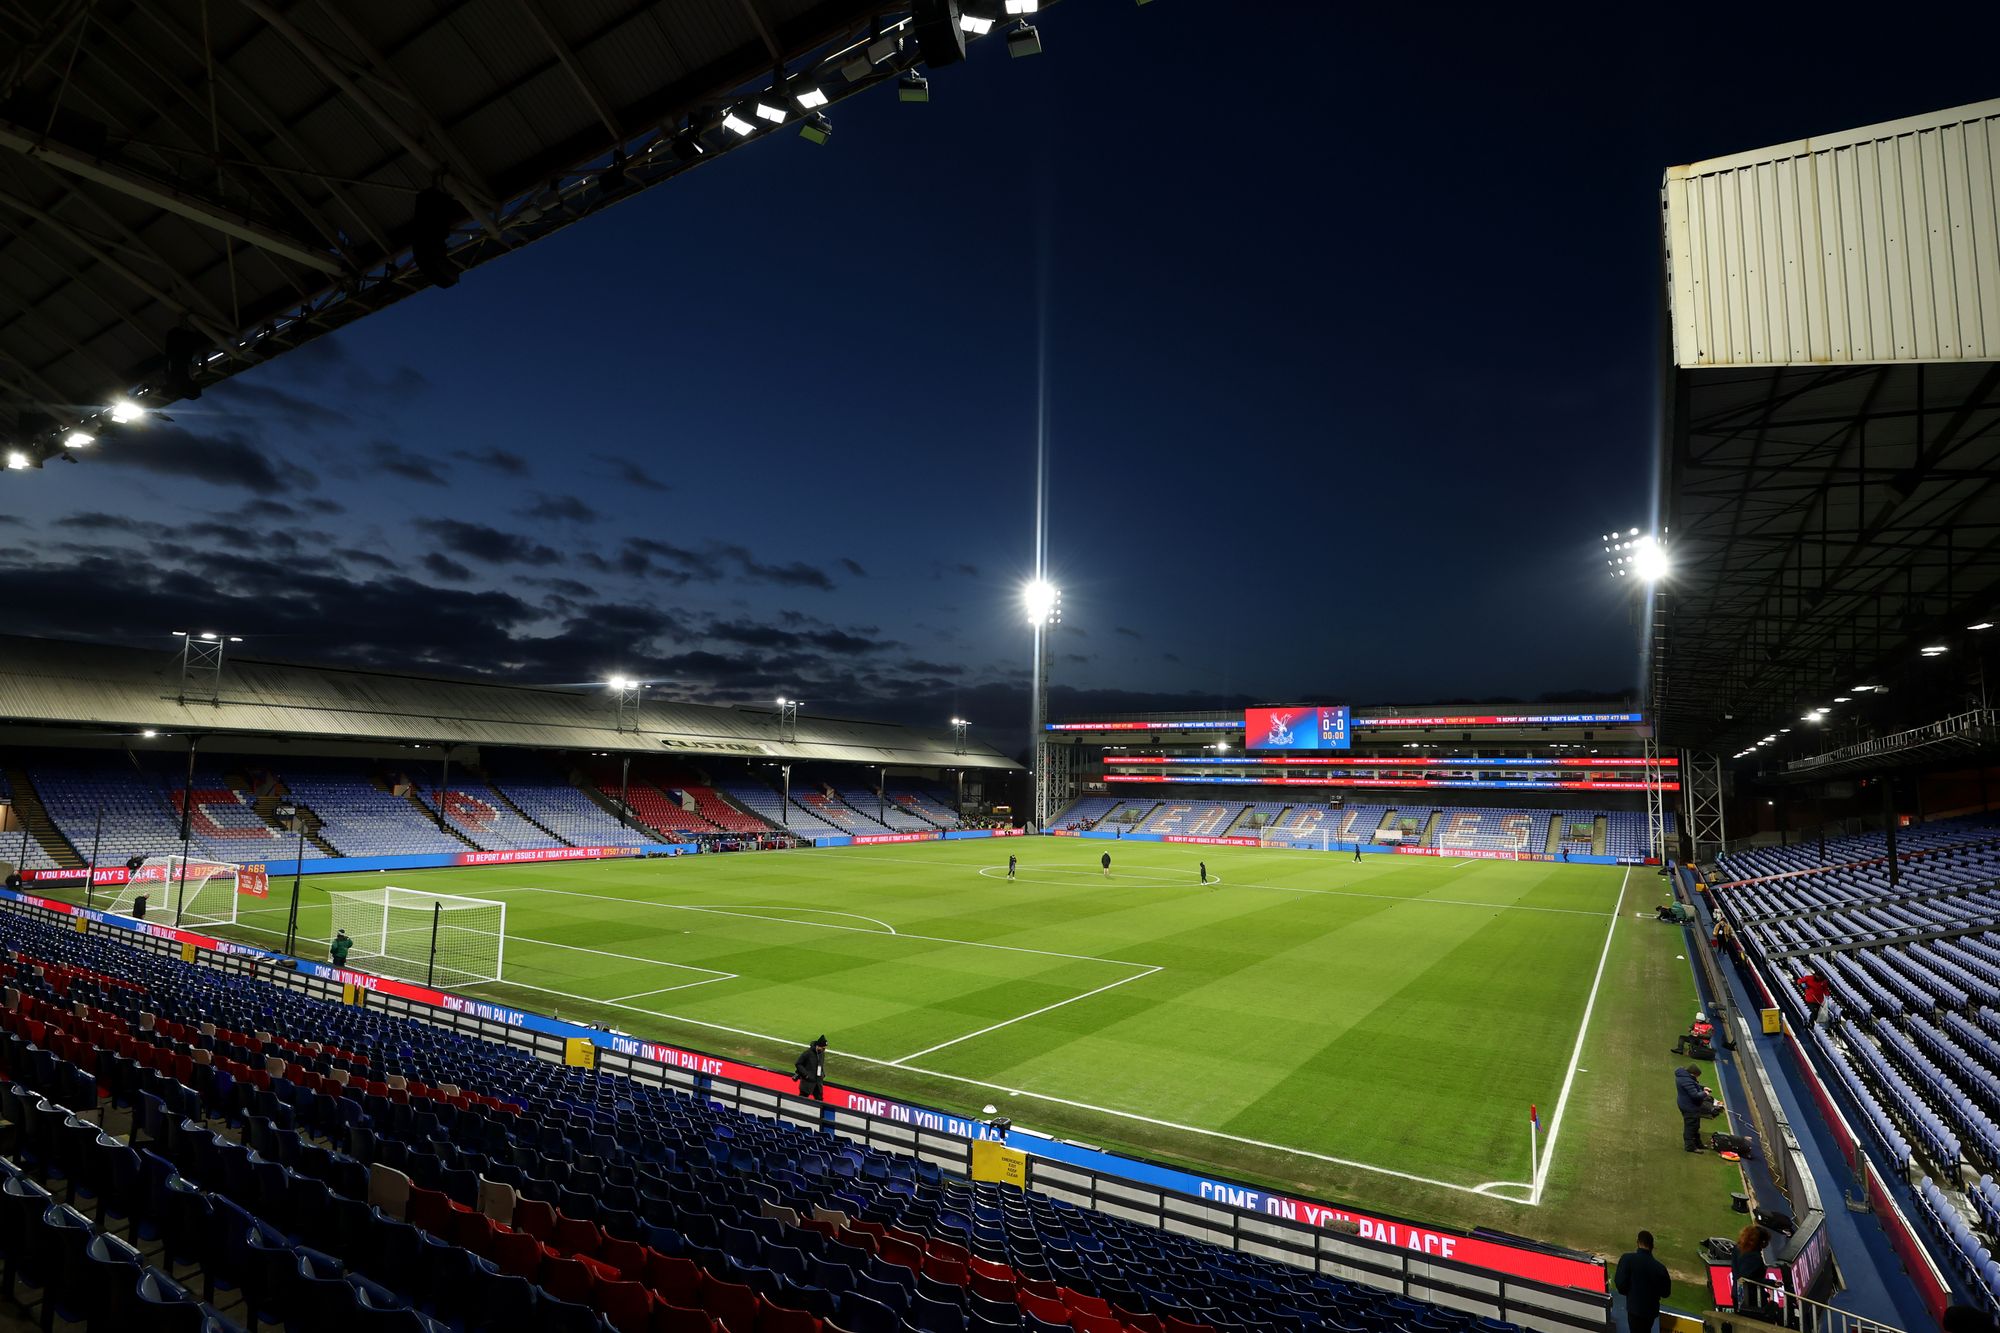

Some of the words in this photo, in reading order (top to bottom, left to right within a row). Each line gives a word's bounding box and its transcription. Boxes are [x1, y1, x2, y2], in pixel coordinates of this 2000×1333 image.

[1323, 719, 1344, 730] 0-0
[248, 864, 265, 873] 669
[476, 854, 500, 862] REPORT
[515, 852, 536, 860] ISSUES
[546, 851, 568, 859] TODAY'S
[316, 965, 331, 979] COME
[332, 969, 341, 982] ON
[342, 971, 353, 984] YOU
[354, 974, 377, 990] PALACE
[443, 996, 464, 1012] COME
[465, 1001, 476, 1015] ON
[477, 1004, 492, 1019] YOU
[494, 1007, 524, 1026] PALACE
[613, 1036, 638, 1056] COME
[642, 1043, 655, 1060] ON
[658, 1047, 678, 1065] YOU
[682, 1053, 723, 1076] PALACE
[848, 1094, 886, 1117] COME
[891, 1105, 909, 1122] ON
[914, 1110, 942, 1132] YOU
[1200, 1181, 1259, 1210] COME
[1267, 1197, 1296, 1221] ON
[1359, 1220, 1456, 1258] PALACE
